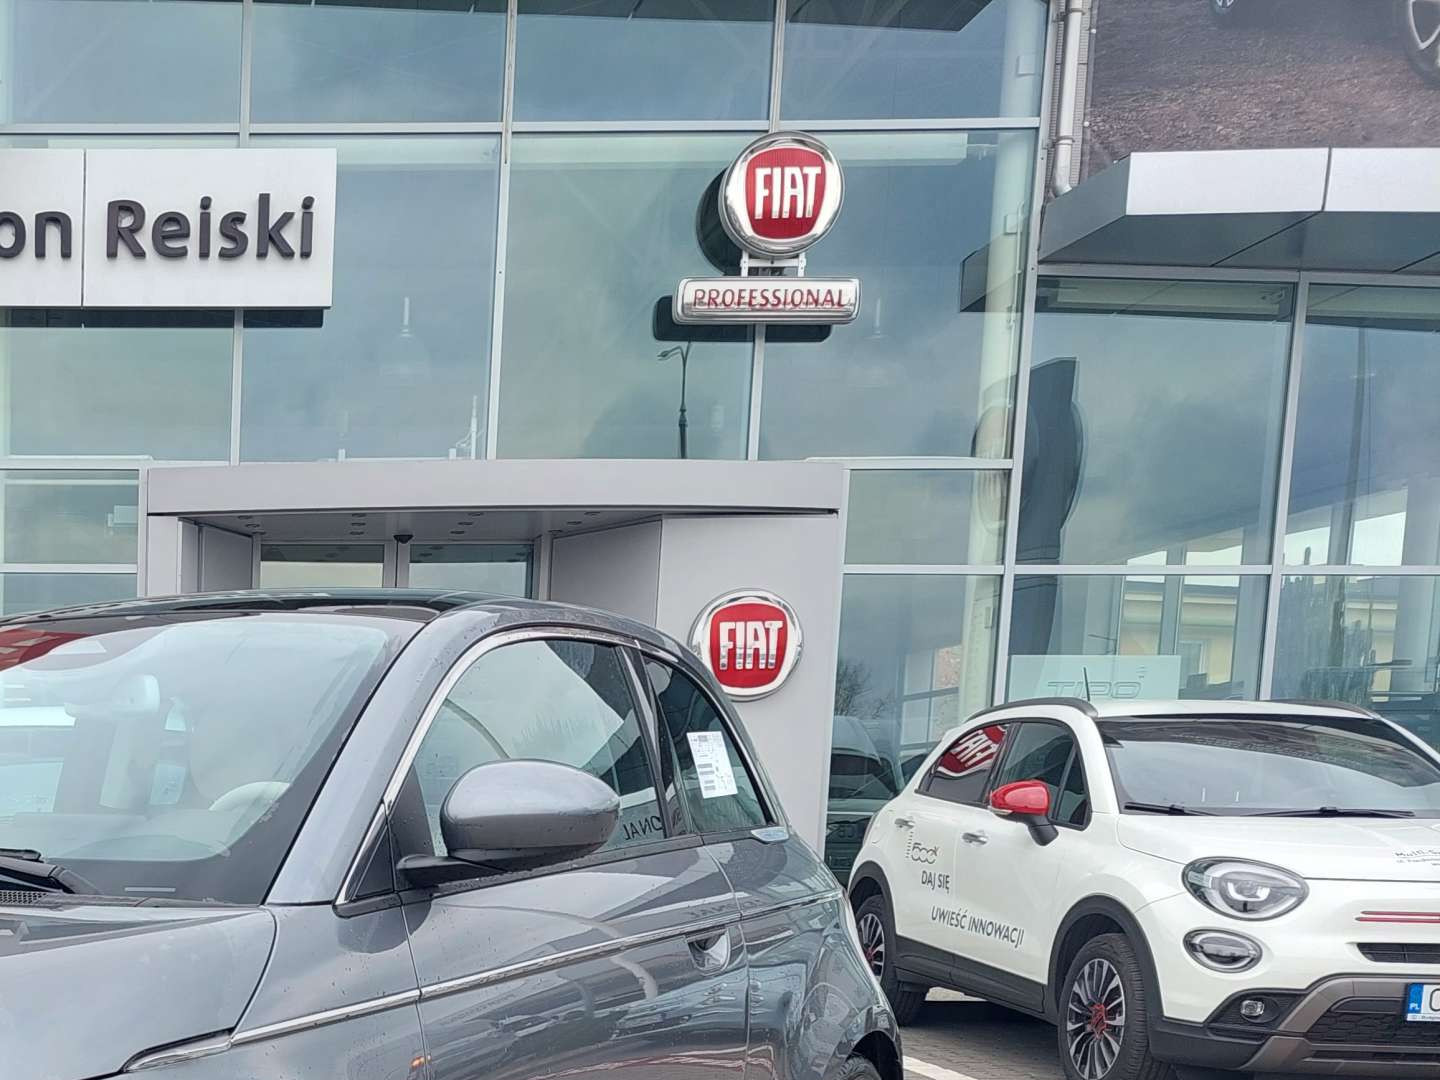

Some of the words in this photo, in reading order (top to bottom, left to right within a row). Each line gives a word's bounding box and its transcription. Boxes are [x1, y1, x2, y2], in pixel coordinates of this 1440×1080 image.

[754, 166, 821, 219] FIAT
[106, 193, 314, 258] Reiski
[693, 288, 845, 308] PROFESSIONAL
[719, 620, 784, 671] FIAT
[1047, 681, 1142, 699] TIPO
[921, 870, 937, 890] DAJ
[937, 873, 950, 894] SIĘ
[931, 905, 968, 929] UWIEŚĆ
[967, 916, 1025, 949] INNOWACJI
